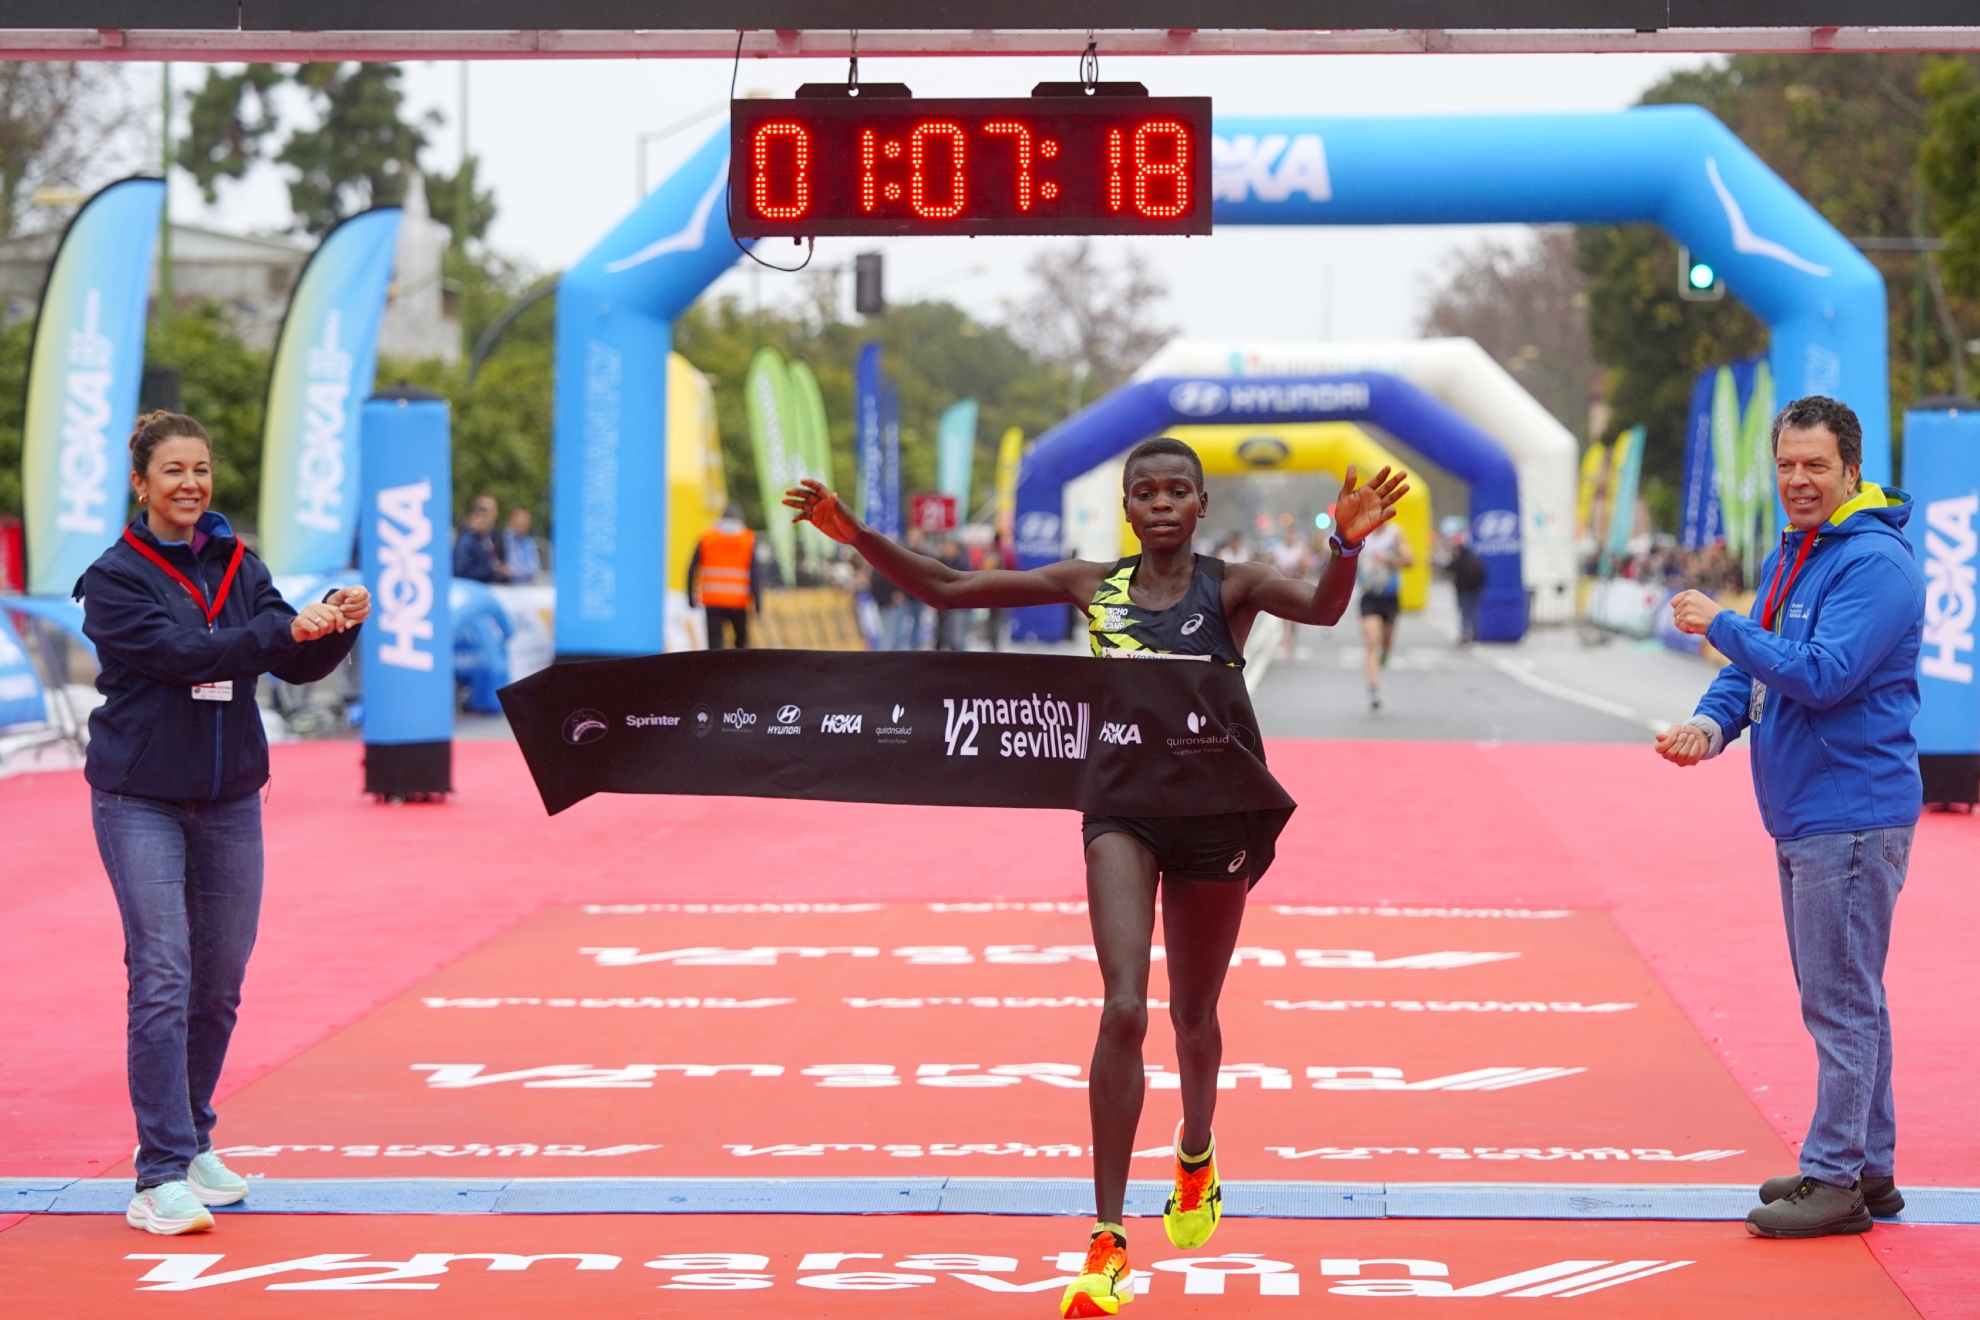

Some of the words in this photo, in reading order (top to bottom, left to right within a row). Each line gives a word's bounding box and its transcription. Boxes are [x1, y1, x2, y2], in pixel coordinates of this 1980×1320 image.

[1212, 134, 1332, 202] KA
[584, 339, 622, 406] FLY
[1230, 382, 1370, 413] HYUNDAI
[57, 370, 113, 535] HOKA
[296, 380, 350, 533] HOKA
[582, 407, 620, 555] HUMAN
[377, 481, 434, 671] HOKA
[581, 554, 616, 620] FLY
[1921, 494, 1979, 685] HOKA
[1104, 622, 1125, 630] CAMP
[625, 714, 681, 728] Sprinter
[767, 726, 801, 735] HYUNDAI
[821, 714, 863, 734] HOKA
[972, 693, 1073, 727] maratón
[1000, 722, 1084, 759] sevilla
